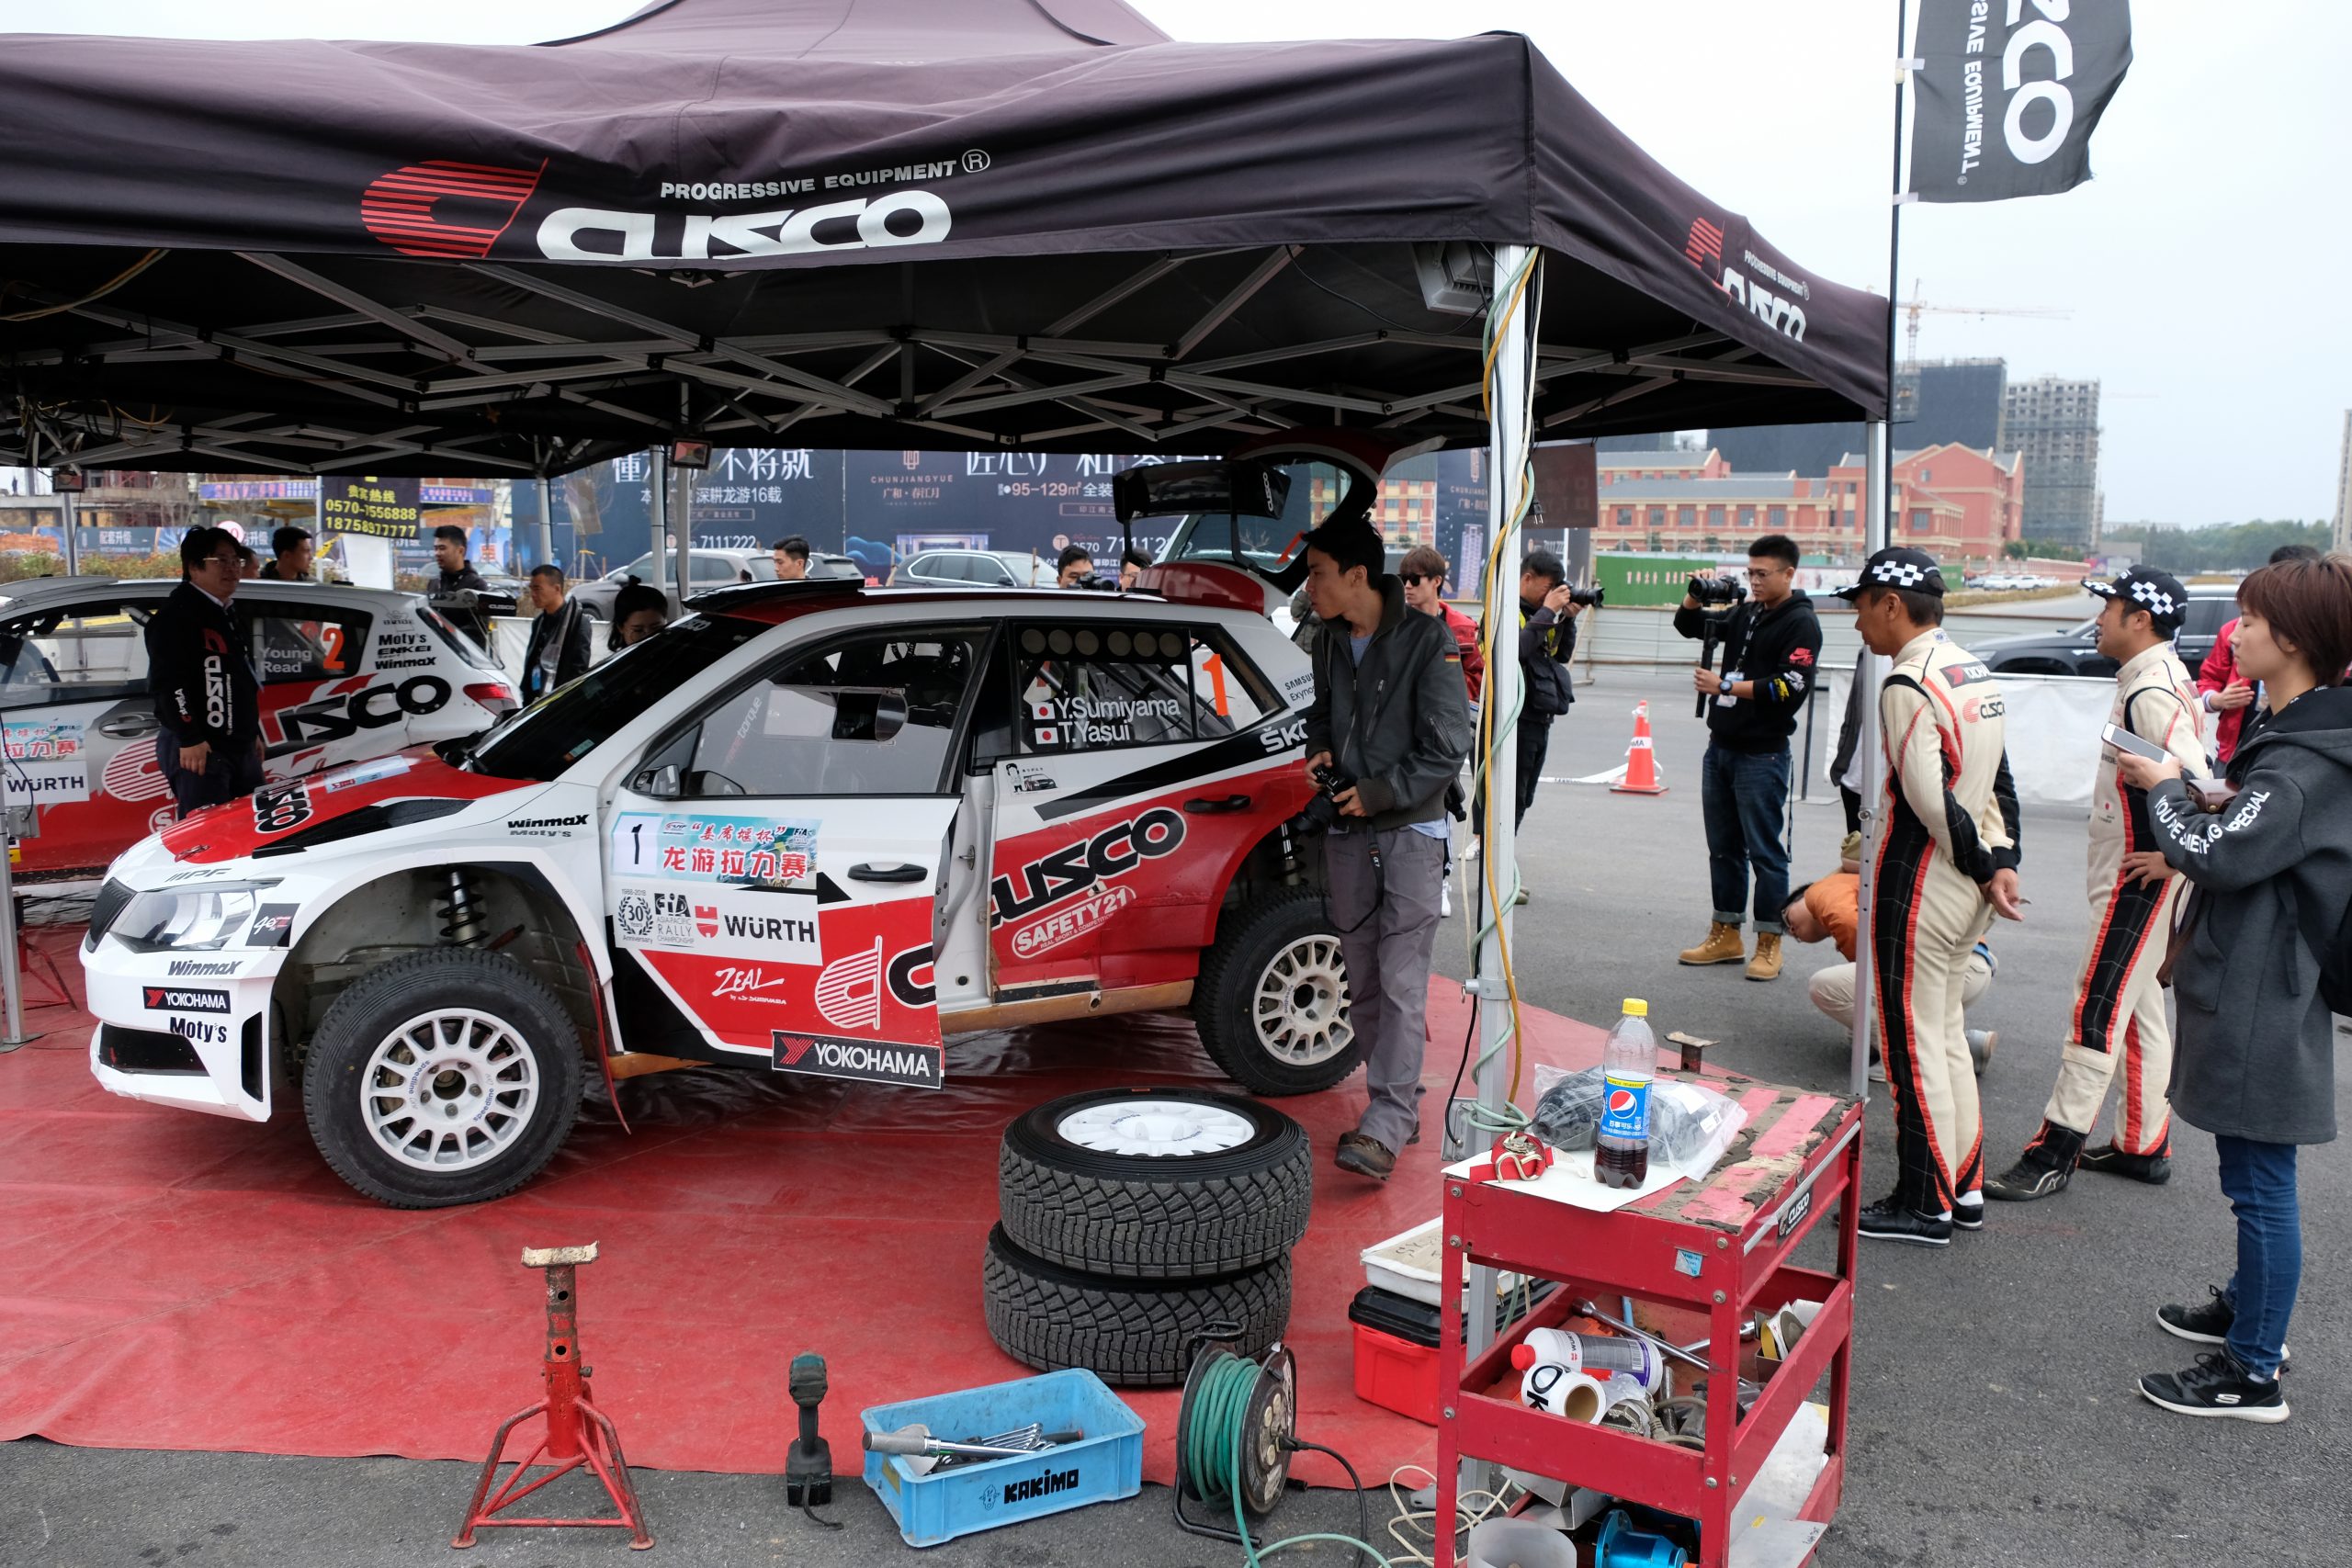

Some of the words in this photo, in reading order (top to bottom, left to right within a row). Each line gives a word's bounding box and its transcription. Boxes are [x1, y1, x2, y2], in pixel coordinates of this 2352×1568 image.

[661, 178, 815, 199] PROGRESSIVE
[824, 160, 957, 189] EQUIPMENT
[1745, 249, 1777, 281] PROGRESSIVE
[870, 475, 954, 484] CHUNJIANGYUE
[347, 484, 396, 504] 贵宾热线
[260, 647, 312, 661] Young
[322, 627, 345, 670] 2
[377, 645, 432, 656] ENKEI
[261, 661, 302, 673] Read
[1202, 653, 1230, 716] 1
[1289, 685, 1316, 702] Exyno
[1054, 695, 1182, 723] Y.Sumiyama
[1057, 719, 1130, 744] T.Yasui
[631, 823, 643, 865] 1
[663, 846, 808, 879] 龙游拉力赛
[628, 905, 644, 922] 30
[1016, 897, 1103, 953] SAFETY
[1103, 887, 1127, 915] 21
[657, 923, 692, 937] RALLY
[1040, 938, 1056, 950] REAL
[1056, 929, 1073, 942] SPORT
[711, 967, 786, 997] ZEAL
[165, 992, 228, 1010] YOKOHAMA
[170, 1016, 228, 1043] Moty's
[814, 1043, 931, 1077] YOKOHAMA
